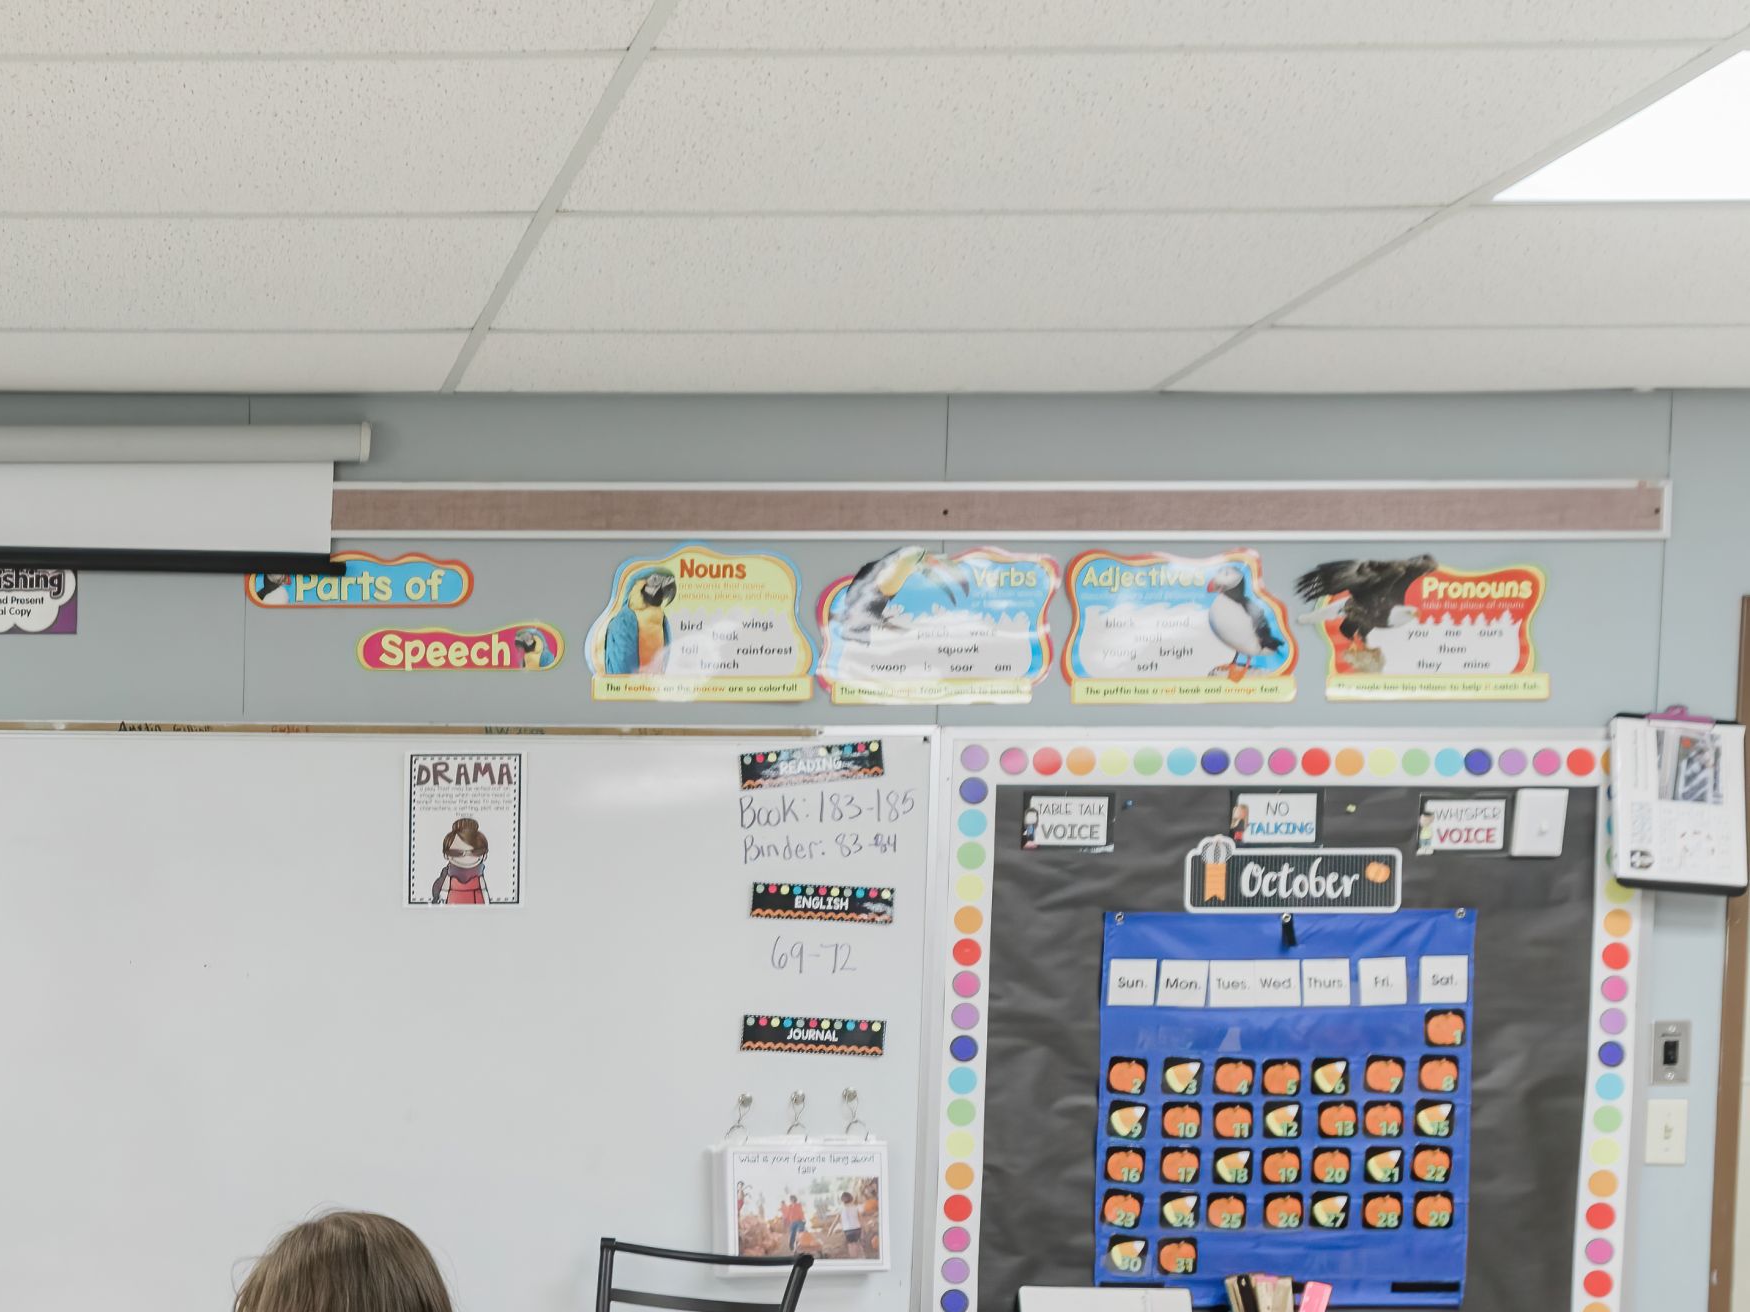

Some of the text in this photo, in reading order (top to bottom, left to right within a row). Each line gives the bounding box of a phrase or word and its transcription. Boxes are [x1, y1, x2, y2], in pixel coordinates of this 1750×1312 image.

[680, 559, 746, 579] Nouns
[296, 570, 445, 601] Parts of
[973, 567, 1036, 588] Verbs
[1083, 566, 1205, 592] Adjectives
[1422, 577, 1533, 599] Pronouns
[11, 596, 44, 605] Present
[9, 607, 31, 617] Copy
[680, 620, 773, 631] bird wings
[1408, 629, 1429, 639] you
[380, 634, 510, 671] Speech
[737, 645, 792, 655] rainforest
[1159, 647, 1194, 659] bright
[1439, 644, 1467, 654] them
[871, 662, 1012, 674] swoop soar am
[1137, 661, 1158, 671] soft
[1417, 659, 1442, 671] they
[416, 762, 513, 785] DRAMA
[779, 757, 841, 775] READING
[740, 789, 916, 828] Book: 183-185
[1039, 803, 1105, 815] TABLE TALK
[1266, 802, 1290, 816] NO
[1041, 824, 1100, 840] VOICE
[1250, 822, 1315, 836] TALKING
[1437, 828, 1496, 843] VOICE
[744, 834, 825, 864] Binder:
[1241, 857, 1360, 899] October
[794, 896, 849, 910] ENGLISH
[771, 936, 856, 974] 69-72
[1118, 976, 1147, 988] Sun.
[1165, 977, 1201, 990] Mon.
[1215, 977, 1250, 989] Tues.
[1307, 977, 1346, 989] Thurs.
[1374, 976, 1393, 987] Fri.
[1432, 974, 1457, 987] Sat.
[786, 1028, 838, 1042] JOURNAL
[1454, 1029, 1462, 1045] 1
[1131, 1076, 1454, 1095] 2 3 4 5 6 7 8
[1131, 1121, 1449, 1137] 9 10 11 12 13 14 15
[1121, 1167, 1446, 1183] 16 17 18 19 20 21 22
[1117, 1210, 1449, 1228] 23 24 25 26 27 28 29
[1176, 1258, 1194, 1273] 31
